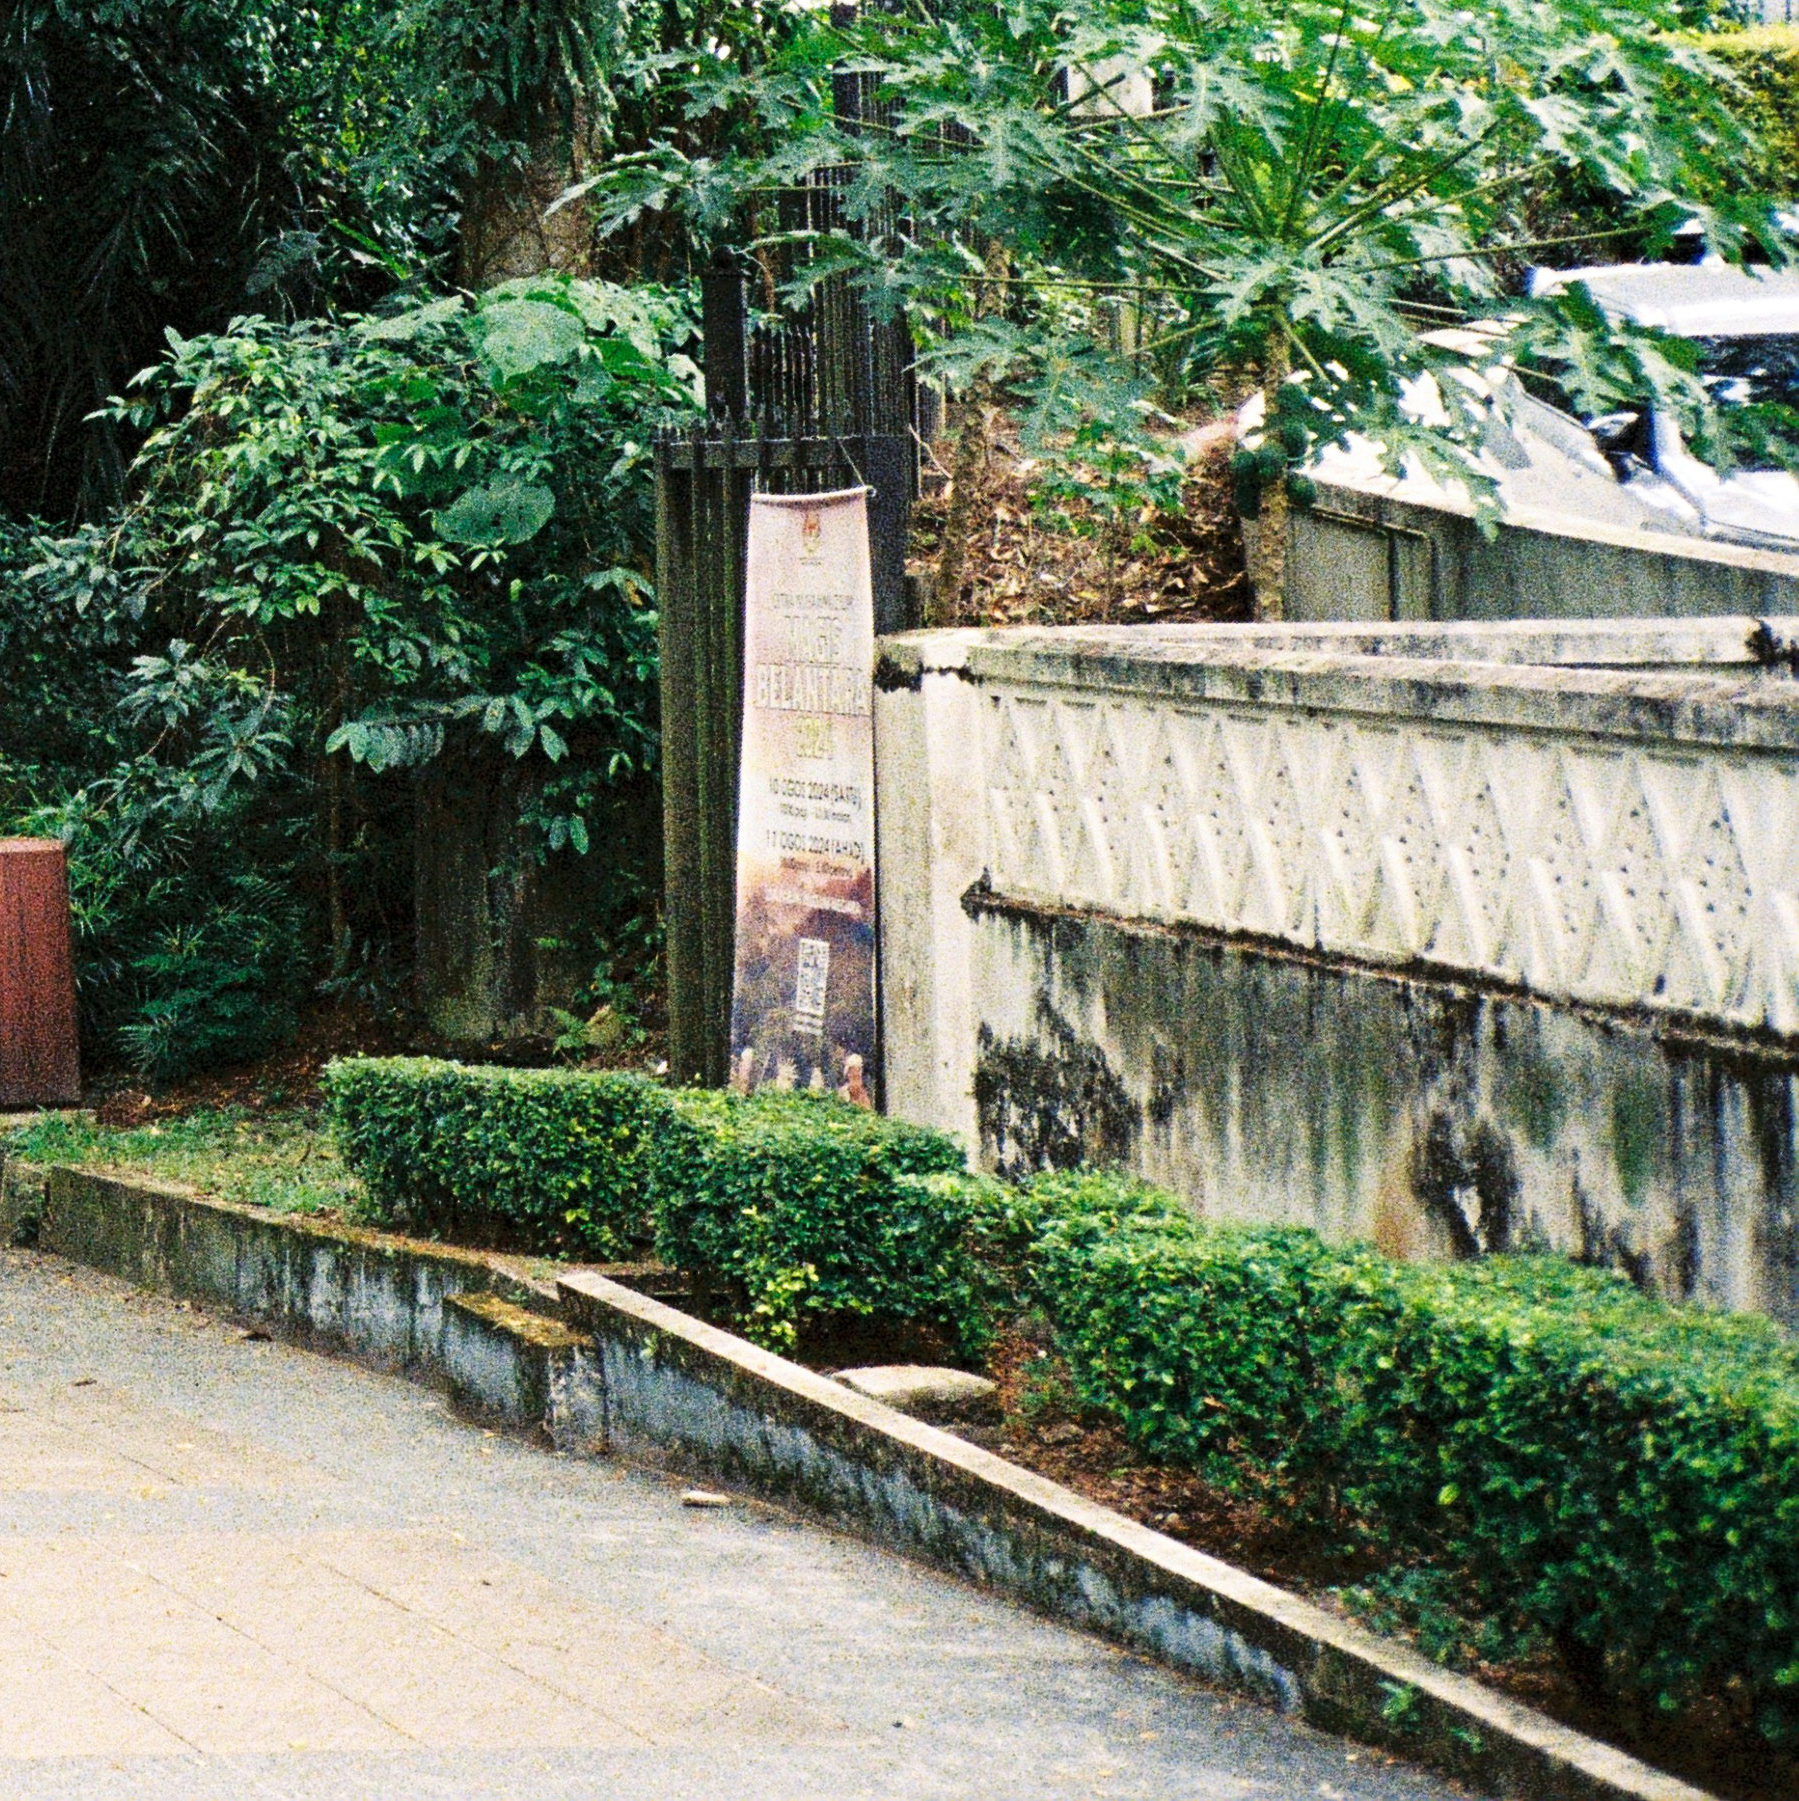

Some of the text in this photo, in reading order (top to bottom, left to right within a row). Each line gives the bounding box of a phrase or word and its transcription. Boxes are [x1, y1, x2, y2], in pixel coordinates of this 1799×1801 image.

[755, 662, 870, 716] BELANTARA
[807, 781, 830, 801] 2024
[807, 834, 830, 855] 2024
